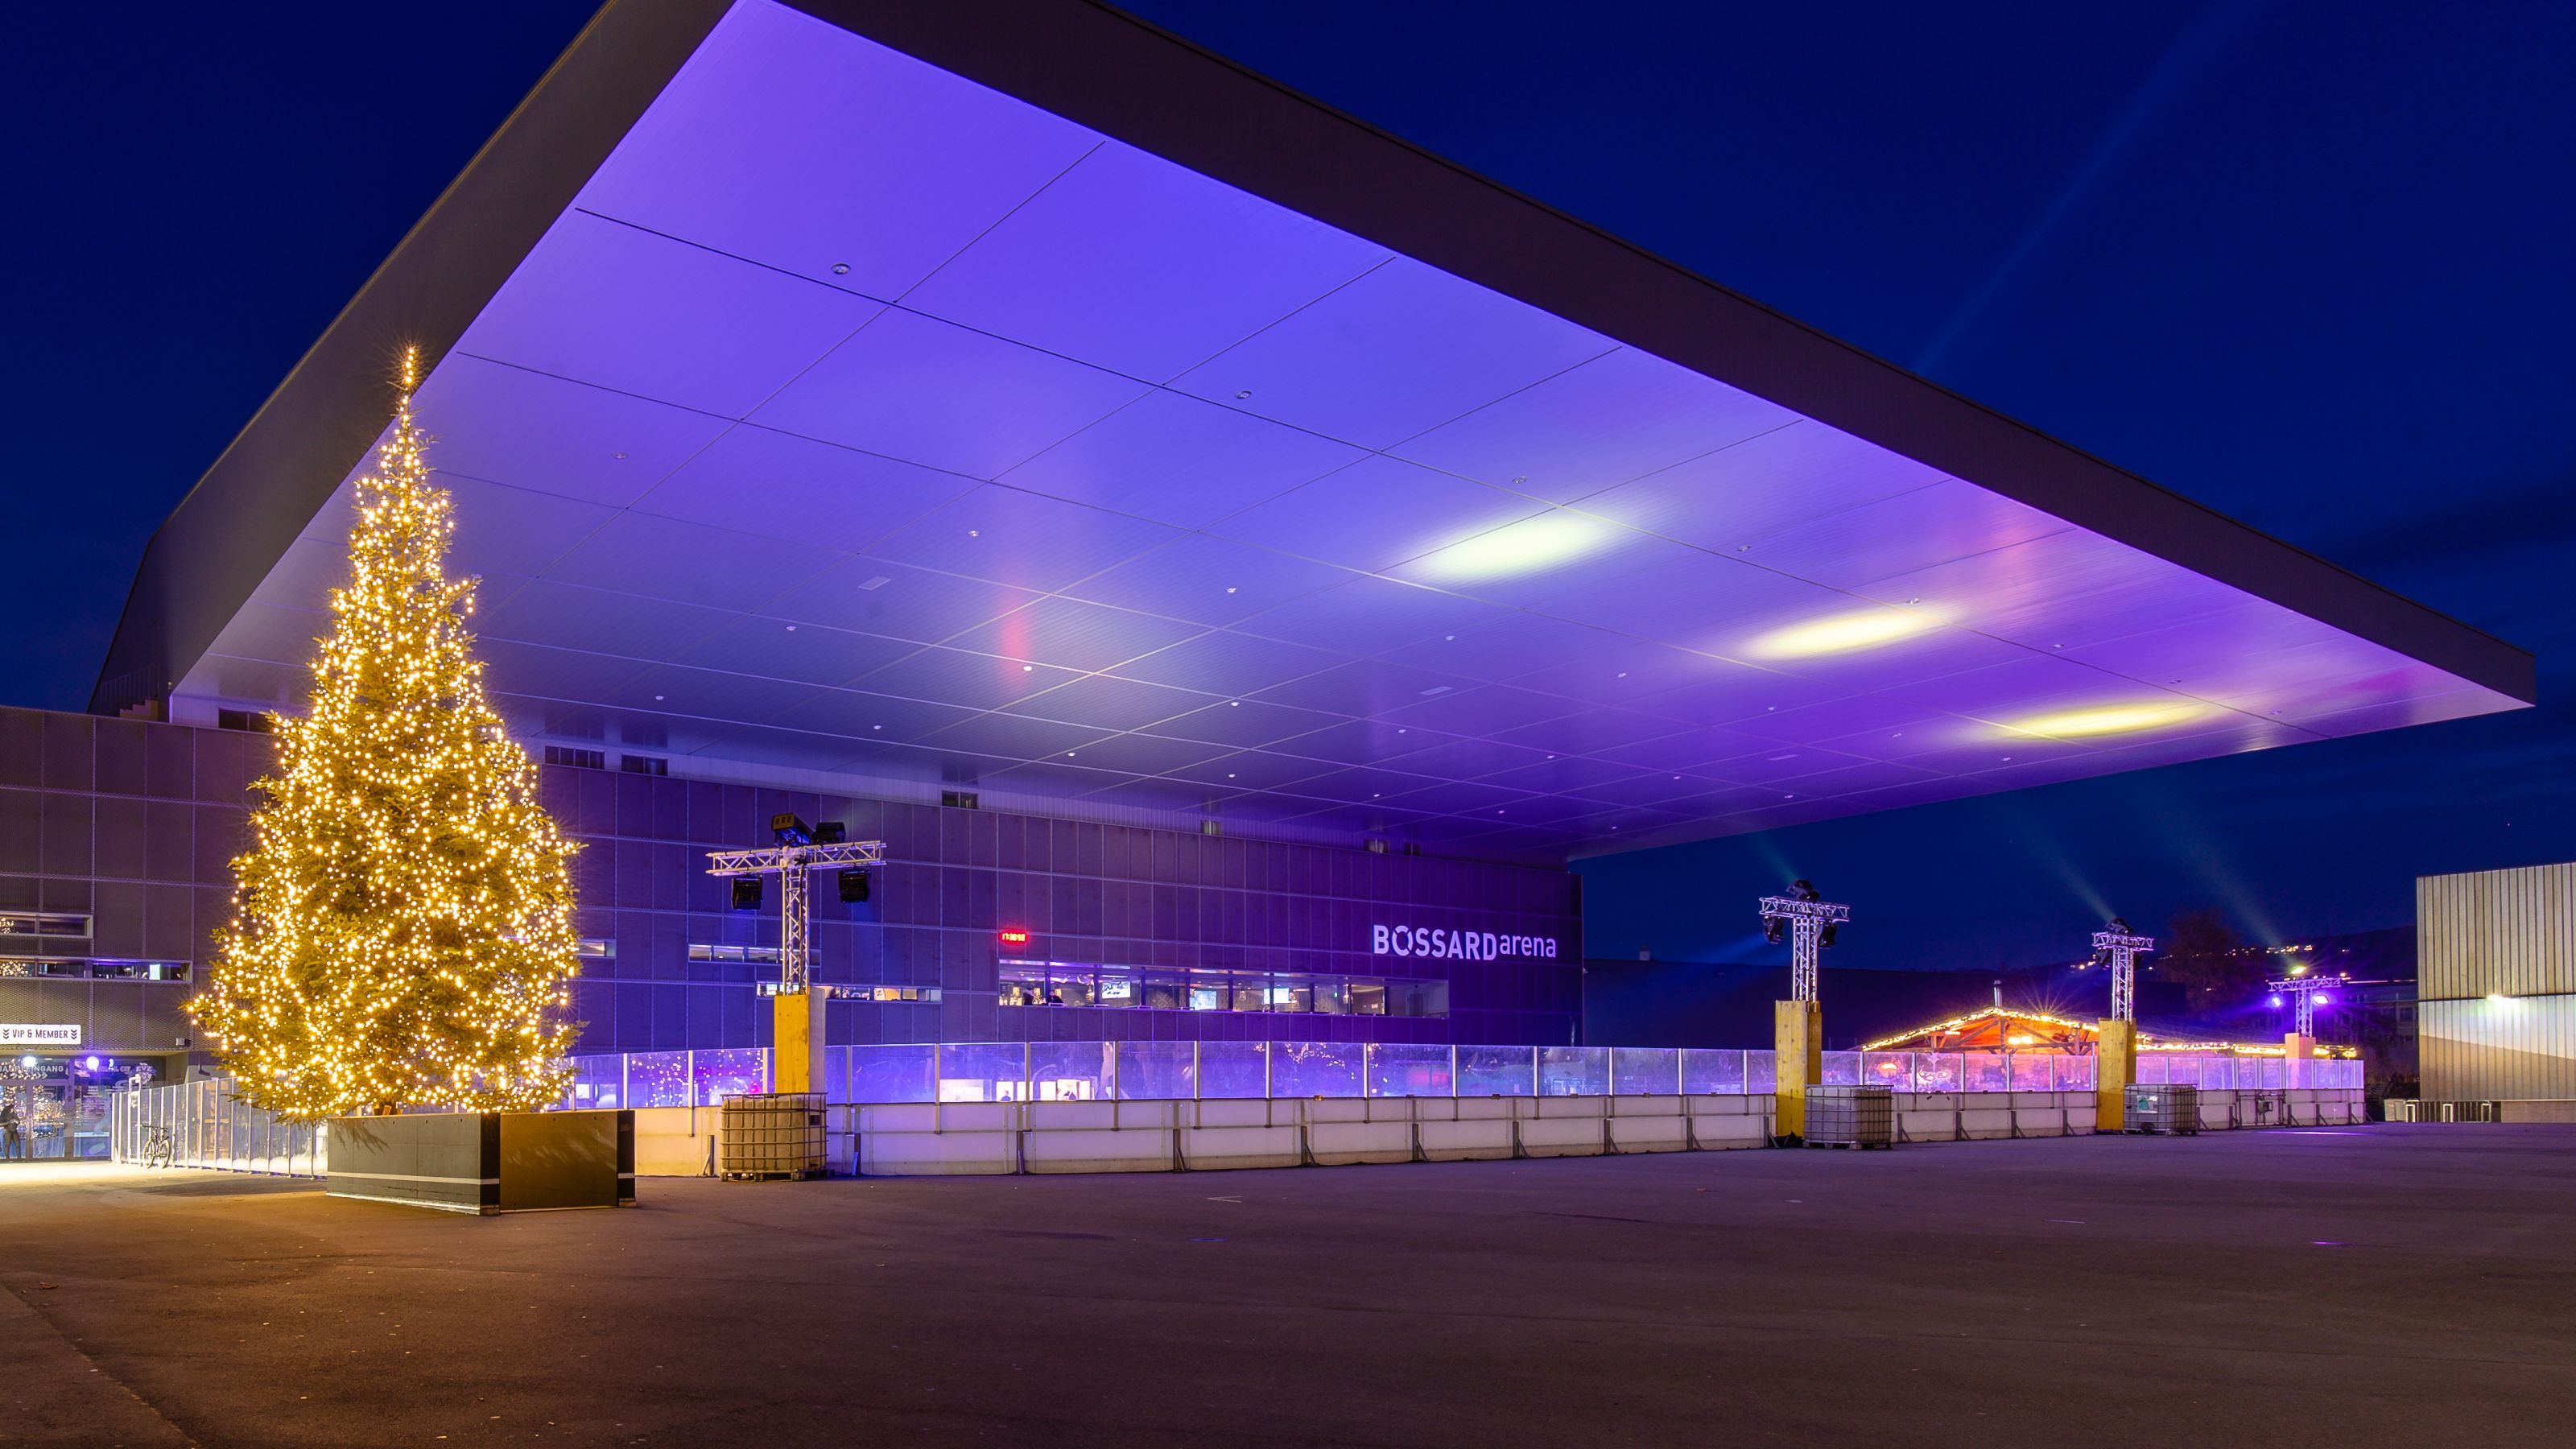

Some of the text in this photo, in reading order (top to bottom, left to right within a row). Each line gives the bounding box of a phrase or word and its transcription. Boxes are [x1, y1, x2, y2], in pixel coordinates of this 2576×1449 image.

[1373, 925, 1556, 960] BOSSARD arena
[27, 1029, 33, 1038] &
[35, 1029, 68, 1038] MEMBER
